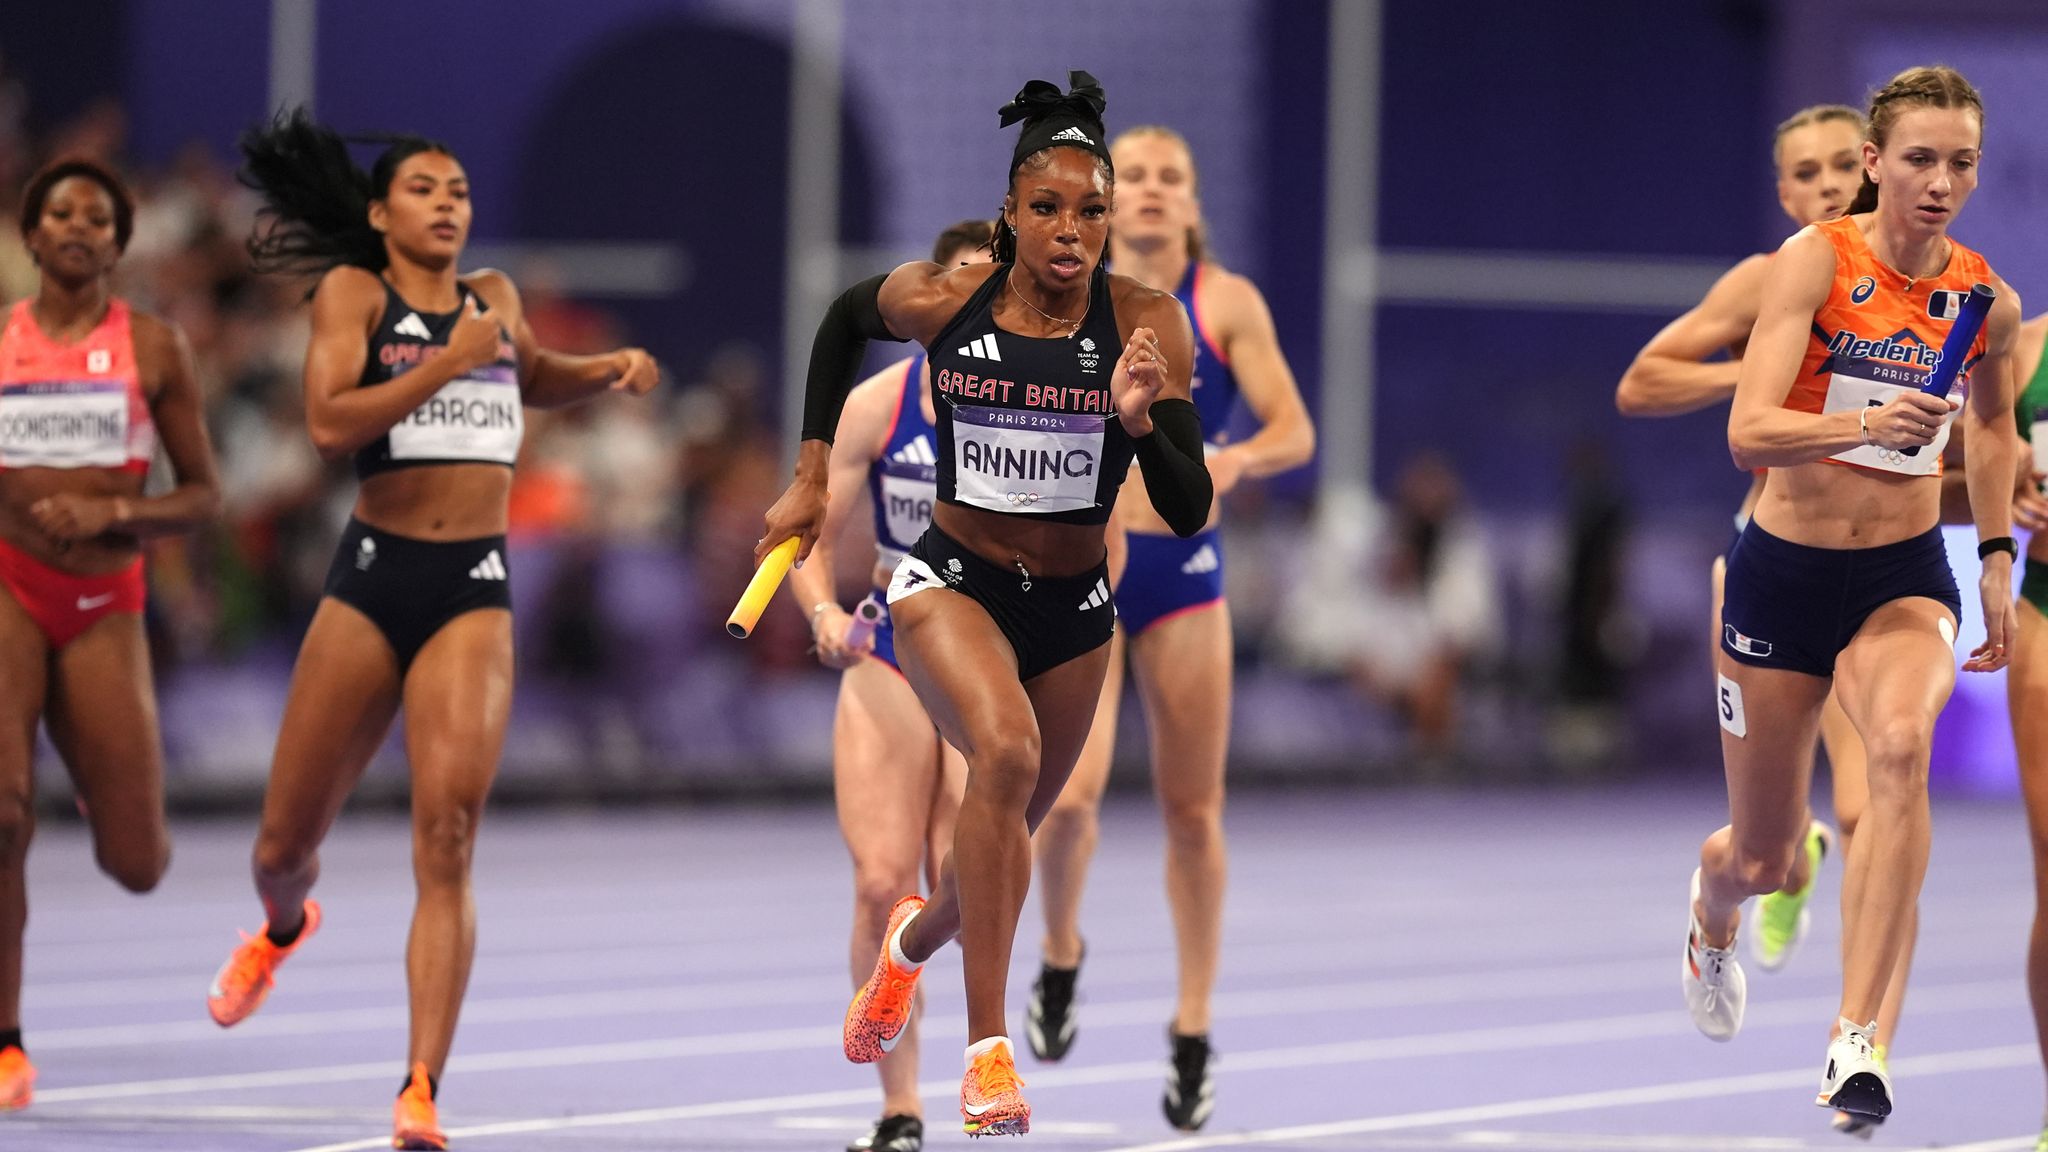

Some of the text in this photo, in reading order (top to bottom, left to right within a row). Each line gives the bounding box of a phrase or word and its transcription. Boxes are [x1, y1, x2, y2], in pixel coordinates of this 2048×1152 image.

[1051, 132, 1095, 146] adidas
[938, 368, 1014, 403] GREAT
[1873, 366, 1910, 382] PARIS
[402, 398, 515, 428] EARGIN
[1031, 416, 1066, 428] 2024
[963, 440, 1094, 480] ANNING
[1721, 686, 1734, 721] 5
